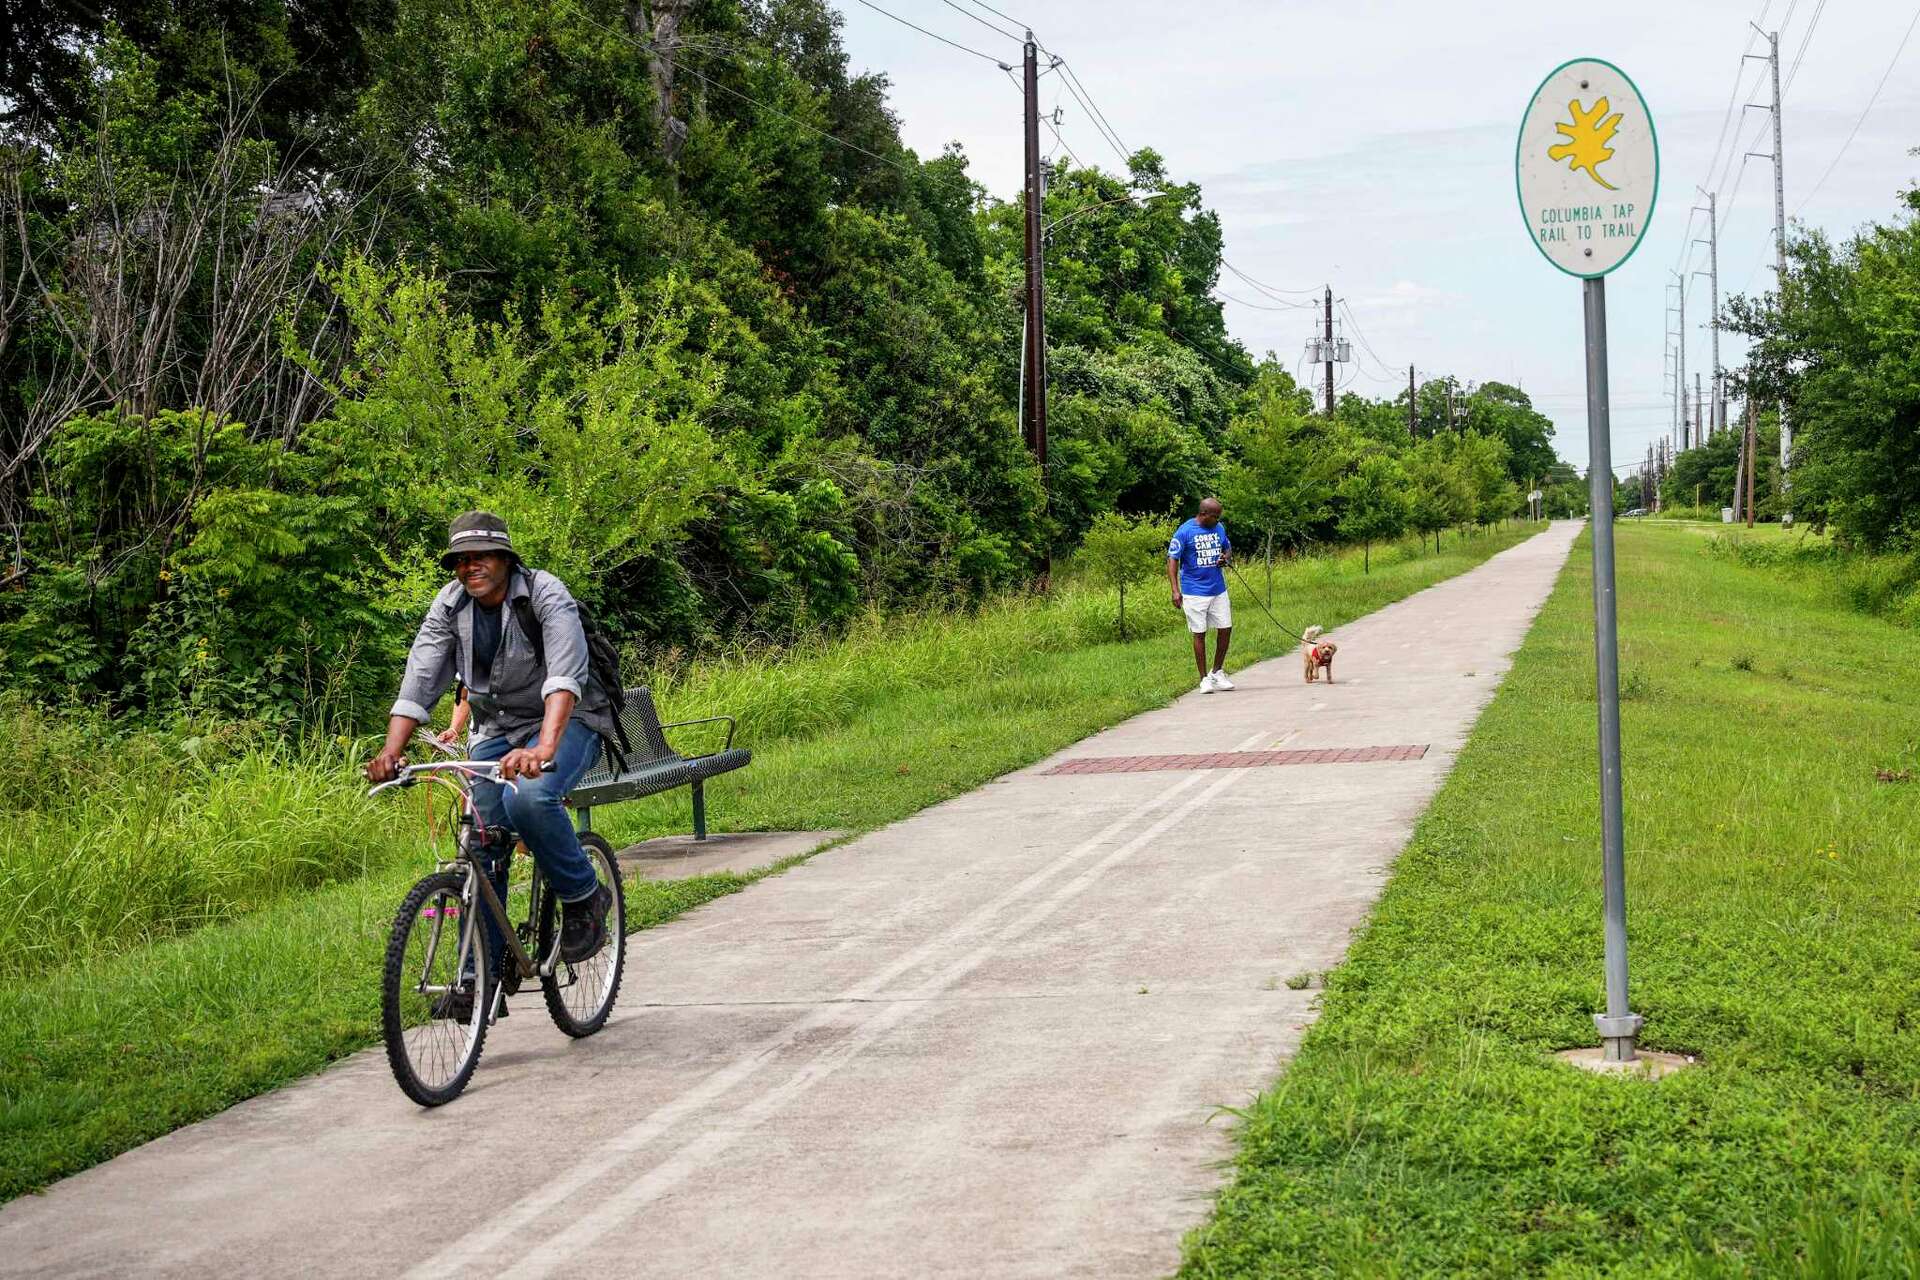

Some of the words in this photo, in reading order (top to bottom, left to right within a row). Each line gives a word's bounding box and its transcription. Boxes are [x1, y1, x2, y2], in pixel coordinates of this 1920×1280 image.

[1541, 206, 1602, 224] COLUMBIA
[1613, 203, 1634, 219] TAP
[1540, 227, 1566, 242] RAIL
[1577, 225, 1591, 240] TO
[1602, 223, 1637, 238] TRAIL
